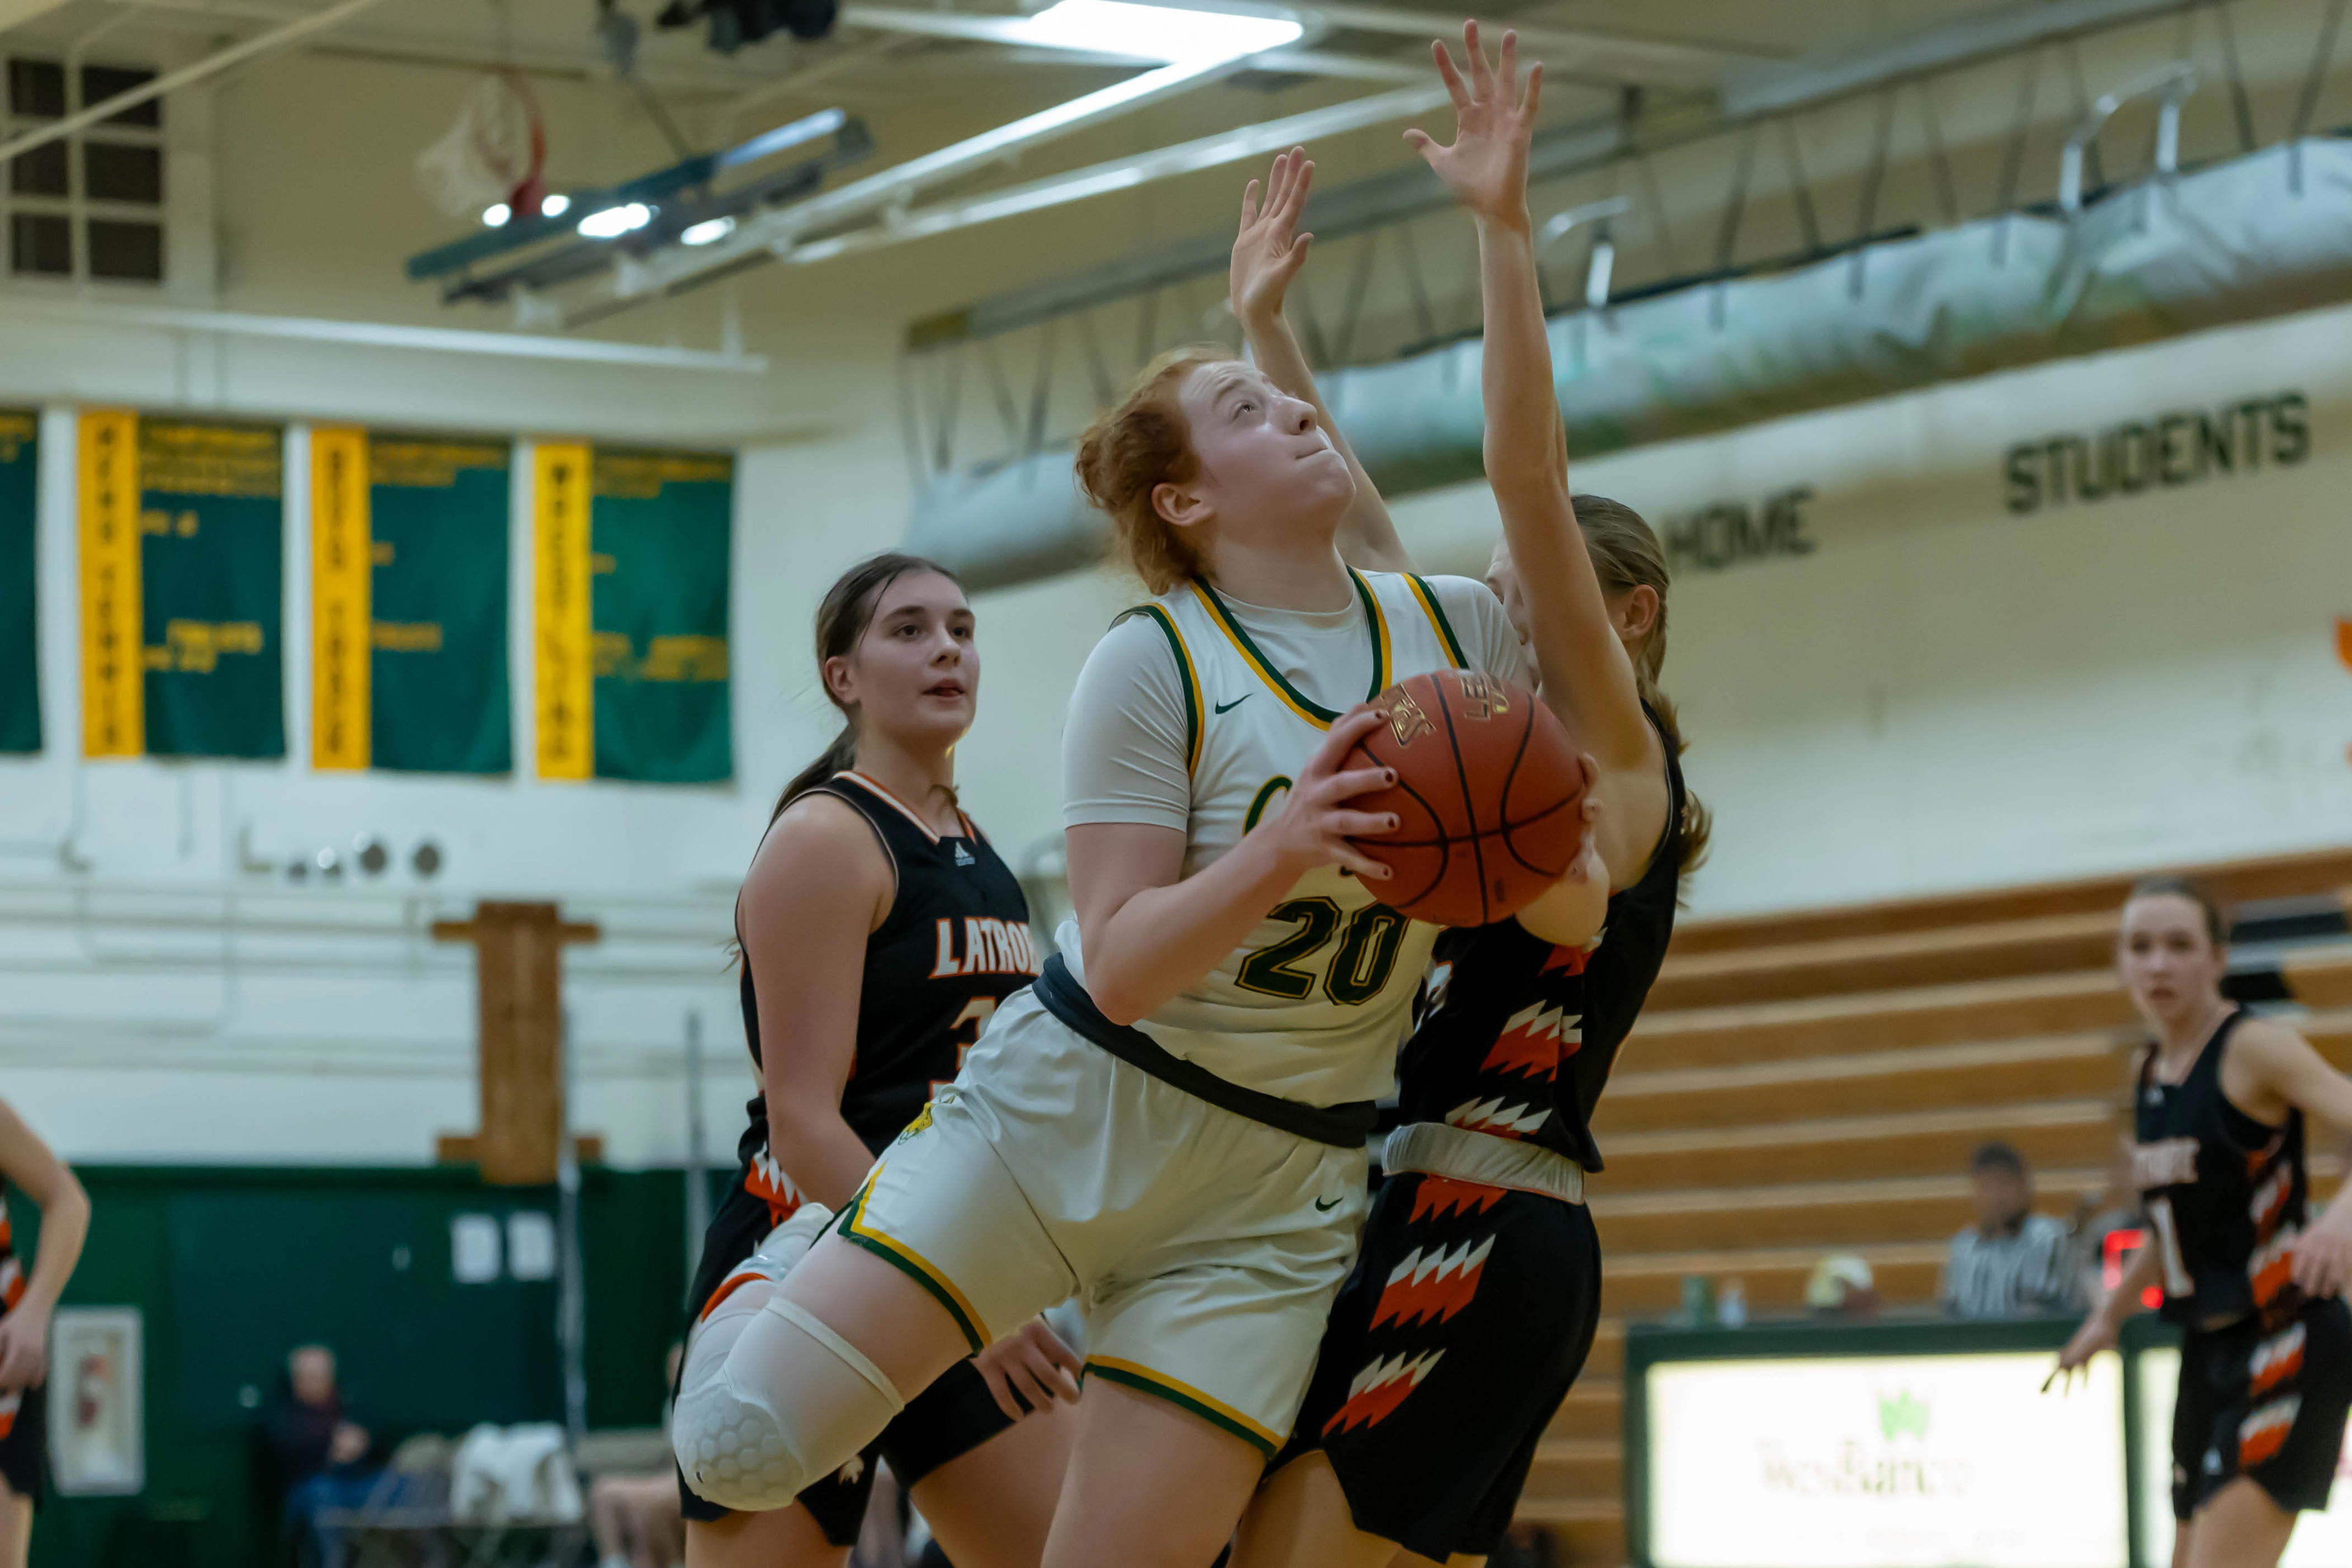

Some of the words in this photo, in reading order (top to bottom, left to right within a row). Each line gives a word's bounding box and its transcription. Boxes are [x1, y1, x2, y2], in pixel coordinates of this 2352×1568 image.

[1664, 486, 1817, 570] HOME
[2004, 390, 2310, 514] STUDENTS
[1234, 895, 1411, 1006] 20
